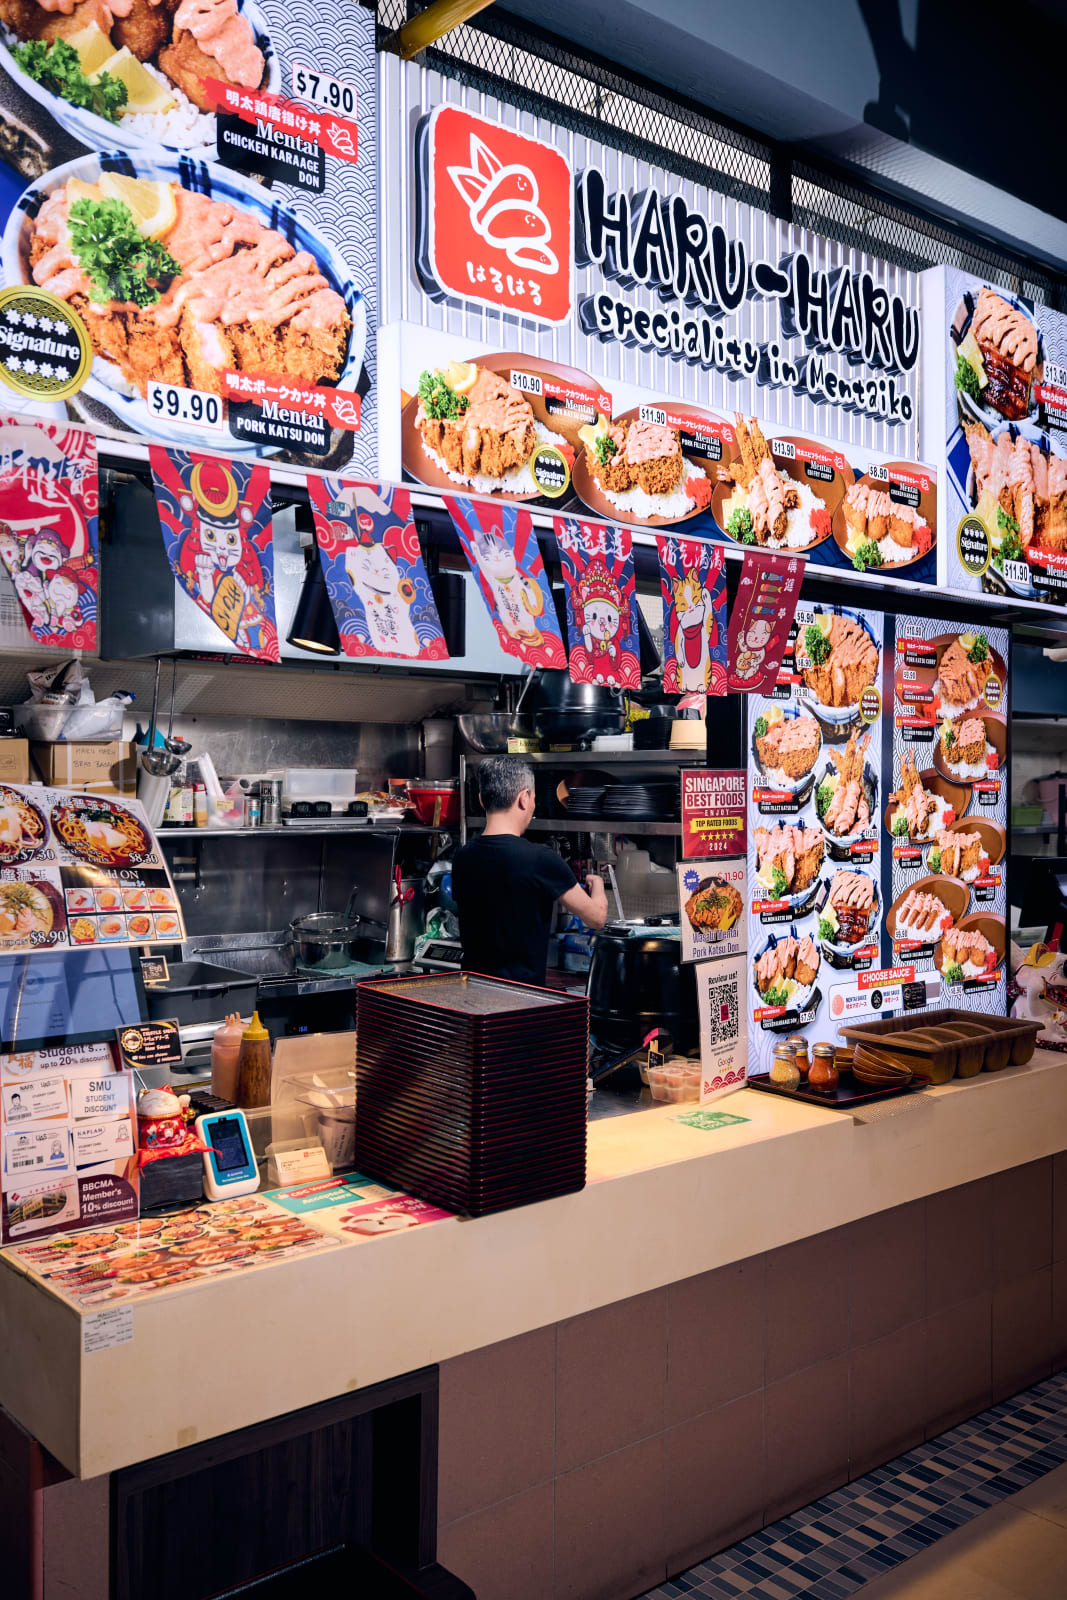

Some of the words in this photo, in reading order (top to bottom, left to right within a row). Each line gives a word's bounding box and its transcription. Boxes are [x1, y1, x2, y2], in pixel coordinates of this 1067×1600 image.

[297, 70, 353, 112] $7.90
[255, 117, 319, 158] Mentai
[223, 130, 269, 156] CHICKEN
[271, 147, 319, 173] KARAAGE
[298, 171, 319, 187] DON
[466, 260, 542, 306] はるはる
[0, 325, 80, 362] Signature
[512, 374, 540, 392] $10.90
[768, 342, 798, 387] in
[807, 355, 914, 425] Mentaiko
[153, 387, 218, 424] $9.90
[564, 397, 594, 415] Mentai
[261, 398, 325, 430] Mentai
[641, 408, 665, 424] $11.90
[236, 417, 266, 435] PORK
[269, 423, 302, 441] KATSU
[304, 429, 325, 446] DON
[695, 431, 720, 446] Mentai
[681, 438, 694, 447] PORK
[694, 441, 707, 450] FILLET
[774, 442, 794, 457] $13.90
[810, 459, 832, 473] Mentai
[870, 466, 888, 480] $8.90
[535, 468, 565, 482] Signature
[961, 536, 988, 552] Signature
[1005, 563, 1028, 582] $11.90
[797, 612, 814, 624] $9.90
[685, 776, 745, 792] SINGAPORE
[686, 793, 715, 808] BEST
[716, 792, 744, 807] FOODS
[706, 819, 721, 827] RATED
[722, 818, 738, 826] FOODS
[709, 842, 728, 850] 2024
[20, 848, 55, 861] $7.30
[128, 852, 159, 864] $8.30
[120, 869, 140, 880] ON
[30, 930, 66, 945] $8.90
[717, 928, 738, 939] Mentai
[692, 947, 706, 958] Pork
[708, 945, 725, 955] Katsu
[727, 942, 740, 953] Don
[708, 974, 728, 985] Review
[728, 970, 738, 981] us!
[862, 971, 889, 983] CHOOSE
[888, 968, 911, 979] SAUCE
[40, 1062, 49, 1070] up
[59, 1057, 78, 1067] 20%
[718, 1055, 734, 1067] Google
[89, 1081, 112, 1092] SMU
[86, 1094, 115, 1102] STUDENT
[84, 1104, 117, 1113] DISCOUNT
[77, 1128, 103, 1137] KAPLAN
[82, 1179, 114, 1192] BBCMA
[82, 1188, 122, 1202] Member's
[81, 1202, 101, 1213] 10%
[102, 1198, 134, 1210] discount
